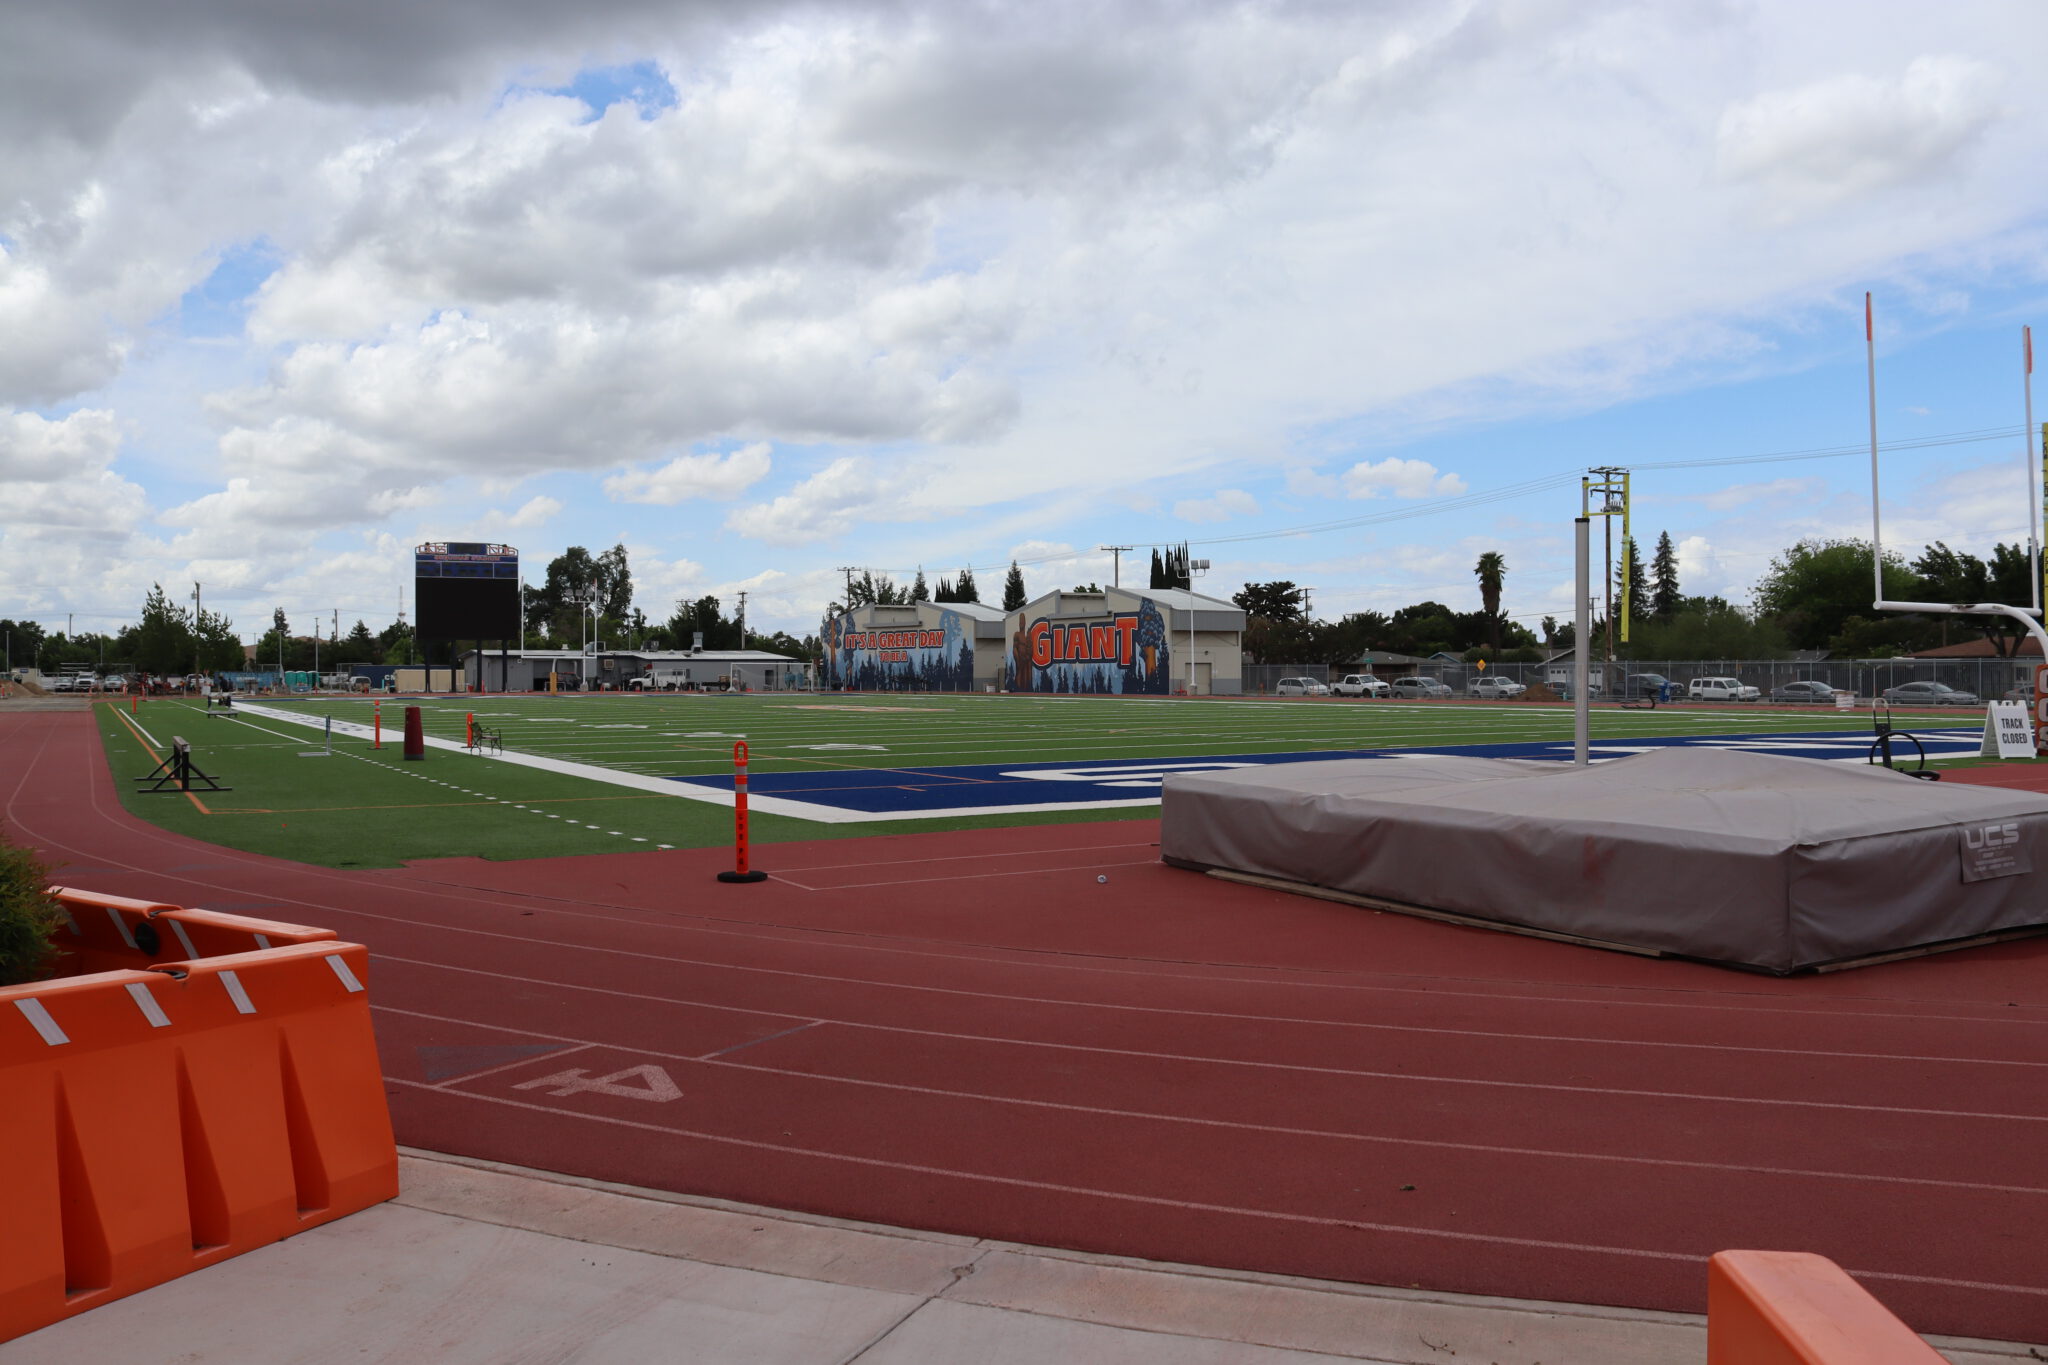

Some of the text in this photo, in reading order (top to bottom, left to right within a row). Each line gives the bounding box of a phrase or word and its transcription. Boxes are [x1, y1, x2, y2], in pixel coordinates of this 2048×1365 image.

[845, 630, 944, 649] IT'S A GREAT DAY
[1029, 615, 1139, 667] GIANT
[891, 652, 900, 661] BE
[901, 651, 907, 661] A
[2001, 718, 2023, 729] TRACK
[2002, 732, 2027, 744] CLOSED
[1964, 823, 2019, 849] UCS
[510, 1064, 683, 1102] 4
